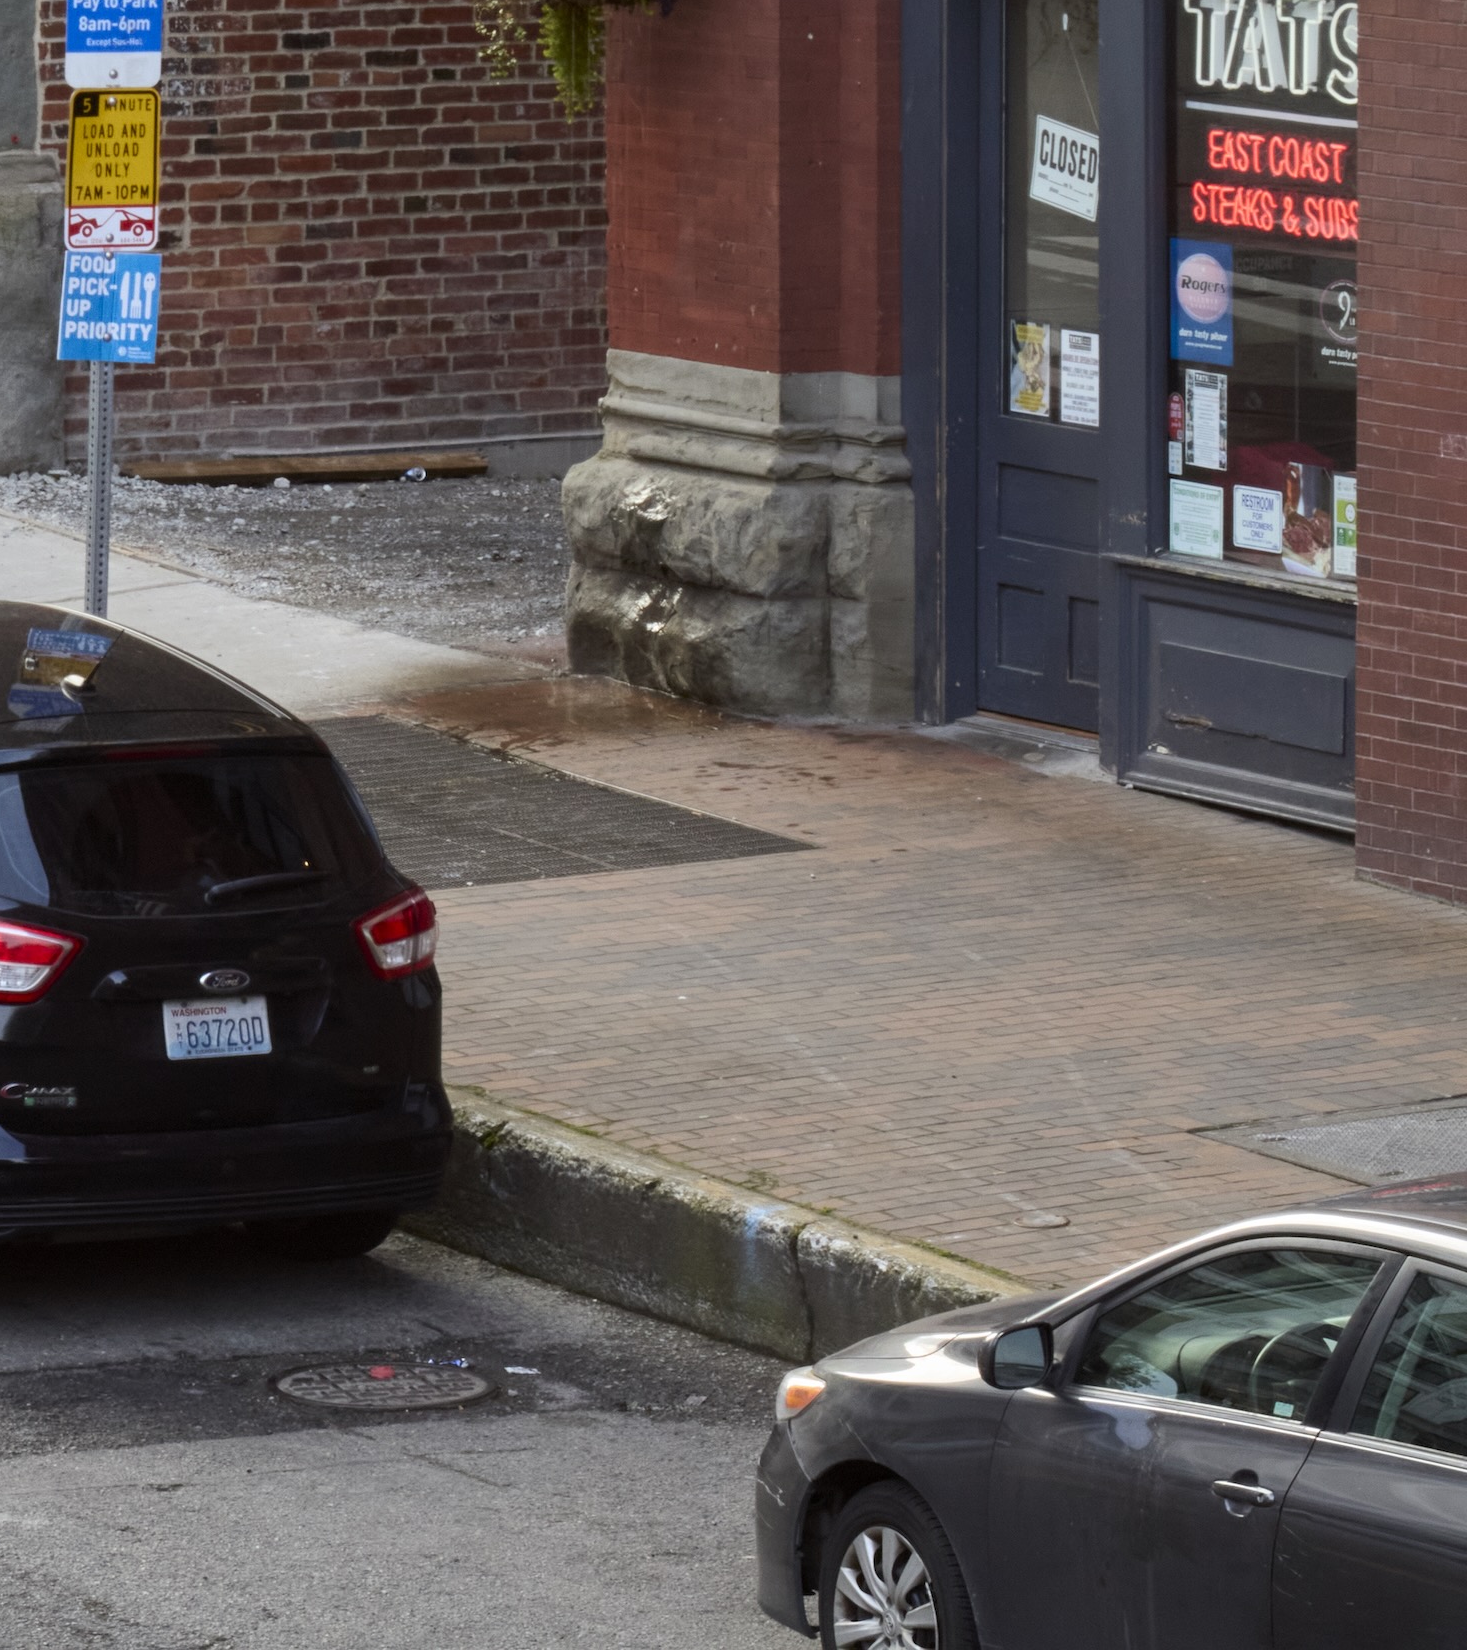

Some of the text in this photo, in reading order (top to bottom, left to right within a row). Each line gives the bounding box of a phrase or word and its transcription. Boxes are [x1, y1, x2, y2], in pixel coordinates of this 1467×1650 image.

[78, 15, 151, 34] 8am-6pm
[86, 37, 112, 47] Except
[83, 97, 92, 113] 5
[83, 124, 146, 139] LOAD AND
[86, 143, 139, 158] UNLOAD
[1040, 128, 1098, 184] CLOSED
[1208, 129, 1348, 184] EAST COAST
[95, 162, 130, 178] ONLY
[1192, 181, 1277, 231] STEAKS
[1283, 196, 1301, 236] &
[70, 255, 116, 274] FOOD
[68, 277, 118, 296] PICK-
[1180, 275, 1226, 294] Rogers
[66, 298, 91, 317] UP
[65, 321, 153, 343] PRIORITY
[1242, 493, 1274, 511] RESTROOM
[1252, 511, 1263, 520] FOR
[1242, 519, 1274, 531] CUSTOMERS
[1250, 530, 1264, 539] ONLY
[212, 974, 239, 988] Ford
[171, 1006, 227, 1017] WASHINGTON
